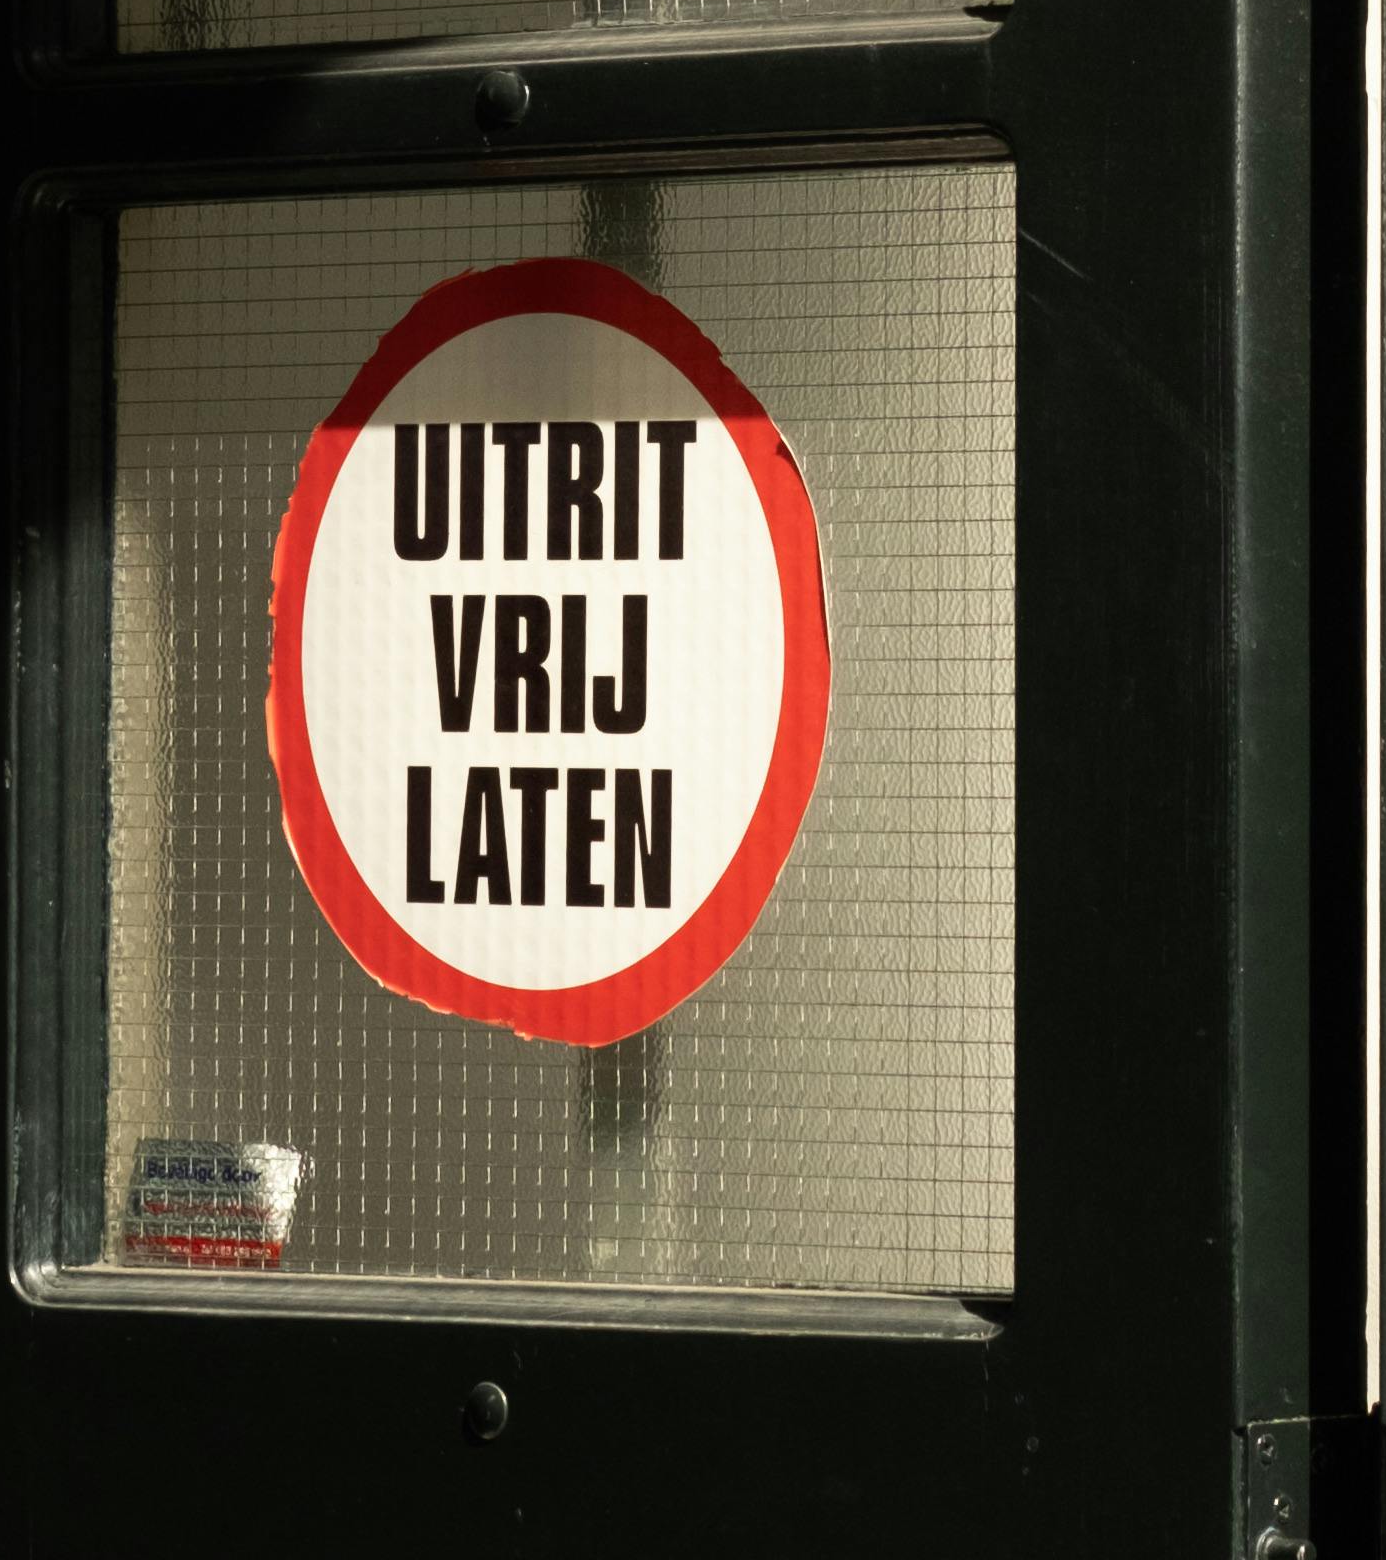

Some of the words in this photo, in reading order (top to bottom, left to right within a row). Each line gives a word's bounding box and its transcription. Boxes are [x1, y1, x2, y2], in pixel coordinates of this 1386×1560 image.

[393, 420, 697, 561] UITRIT
[430, 593, 648, 735] VRIJ
[406, 766, 673, 908] LATEN
